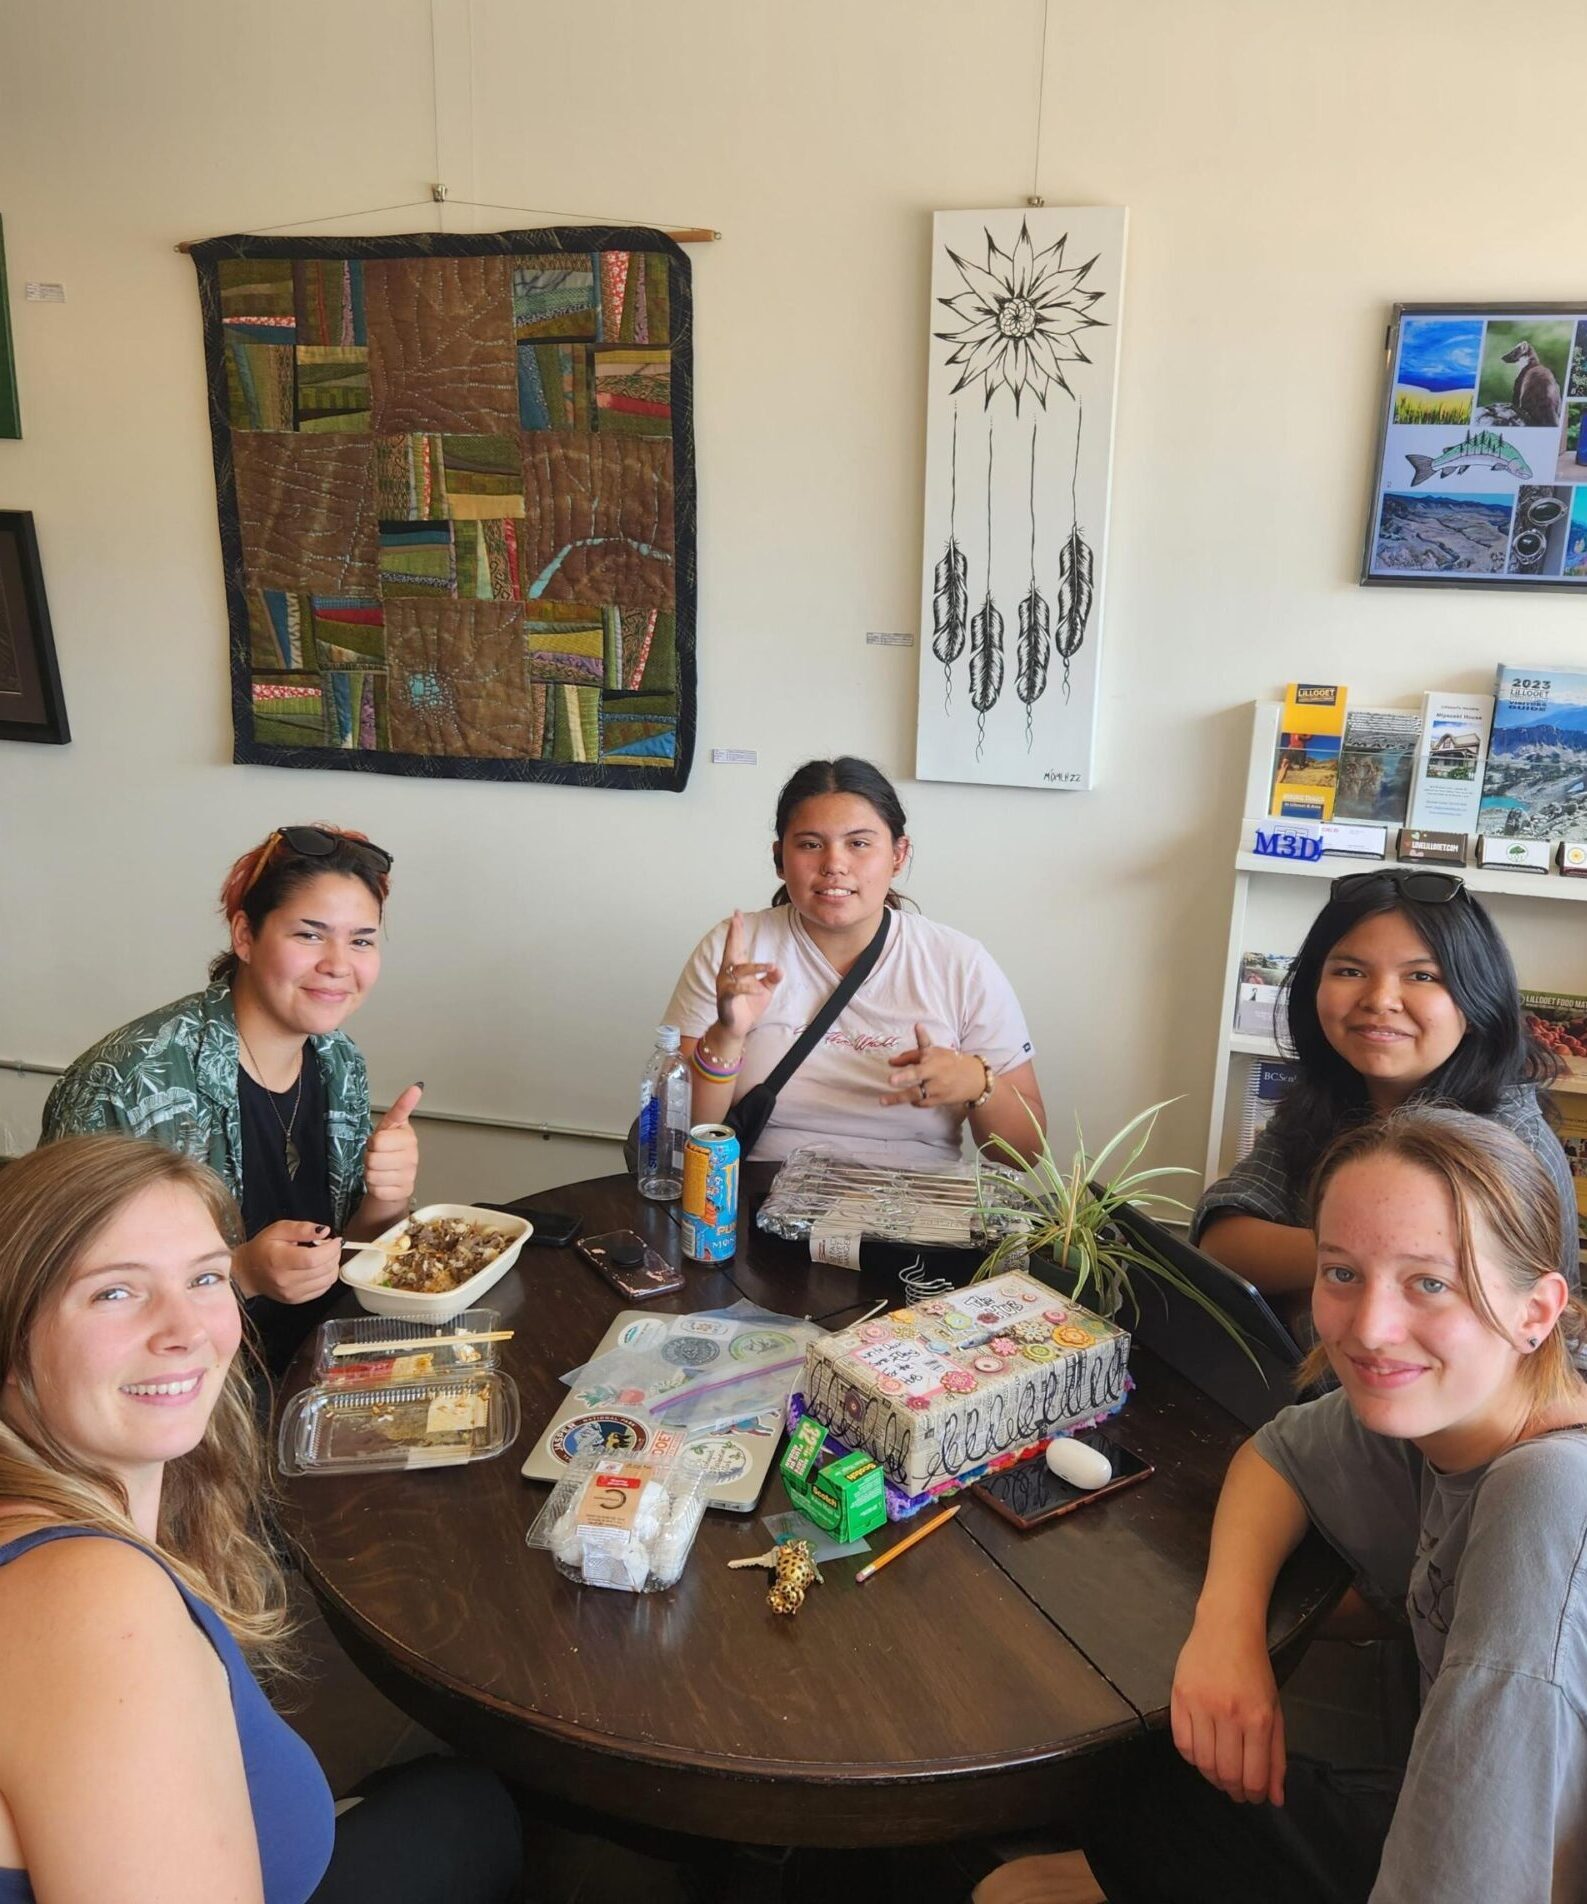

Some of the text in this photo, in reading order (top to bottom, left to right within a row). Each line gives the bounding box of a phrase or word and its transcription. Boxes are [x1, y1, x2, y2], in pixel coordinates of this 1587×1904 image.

[1512, 678, 1551, 690] 2023
[1252, 830, 1324, 862] M3D
[1526, 995, 1555, 1005] LILLOOET
[1556, 998, 1574, 1008] FOOD
[648, 1095, 659, 1168] smartwater
[553, 1415, 635, 1451] JASPER NATIONAL PARK
[845, 1461, 877, 1482] Scotch
[811, 1484, 838, 1509] Scotch
